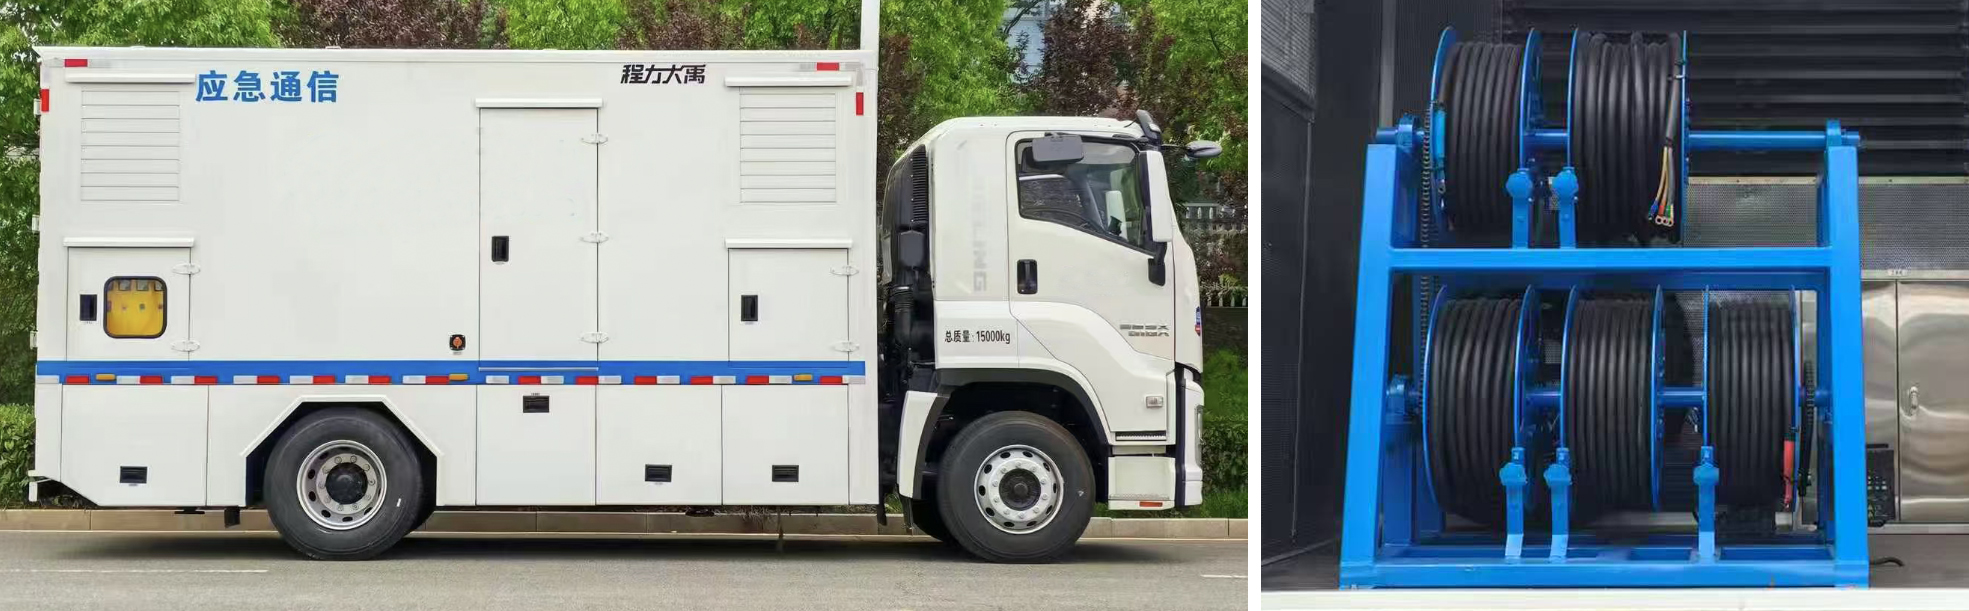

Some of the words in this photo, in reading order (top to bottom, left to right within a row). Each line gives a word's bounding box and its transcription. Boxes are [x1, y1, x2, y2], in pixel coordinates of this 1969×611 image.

[195, 69, 339, 103] 应急通信
[620, 64, 706, 84] 程力大禹
